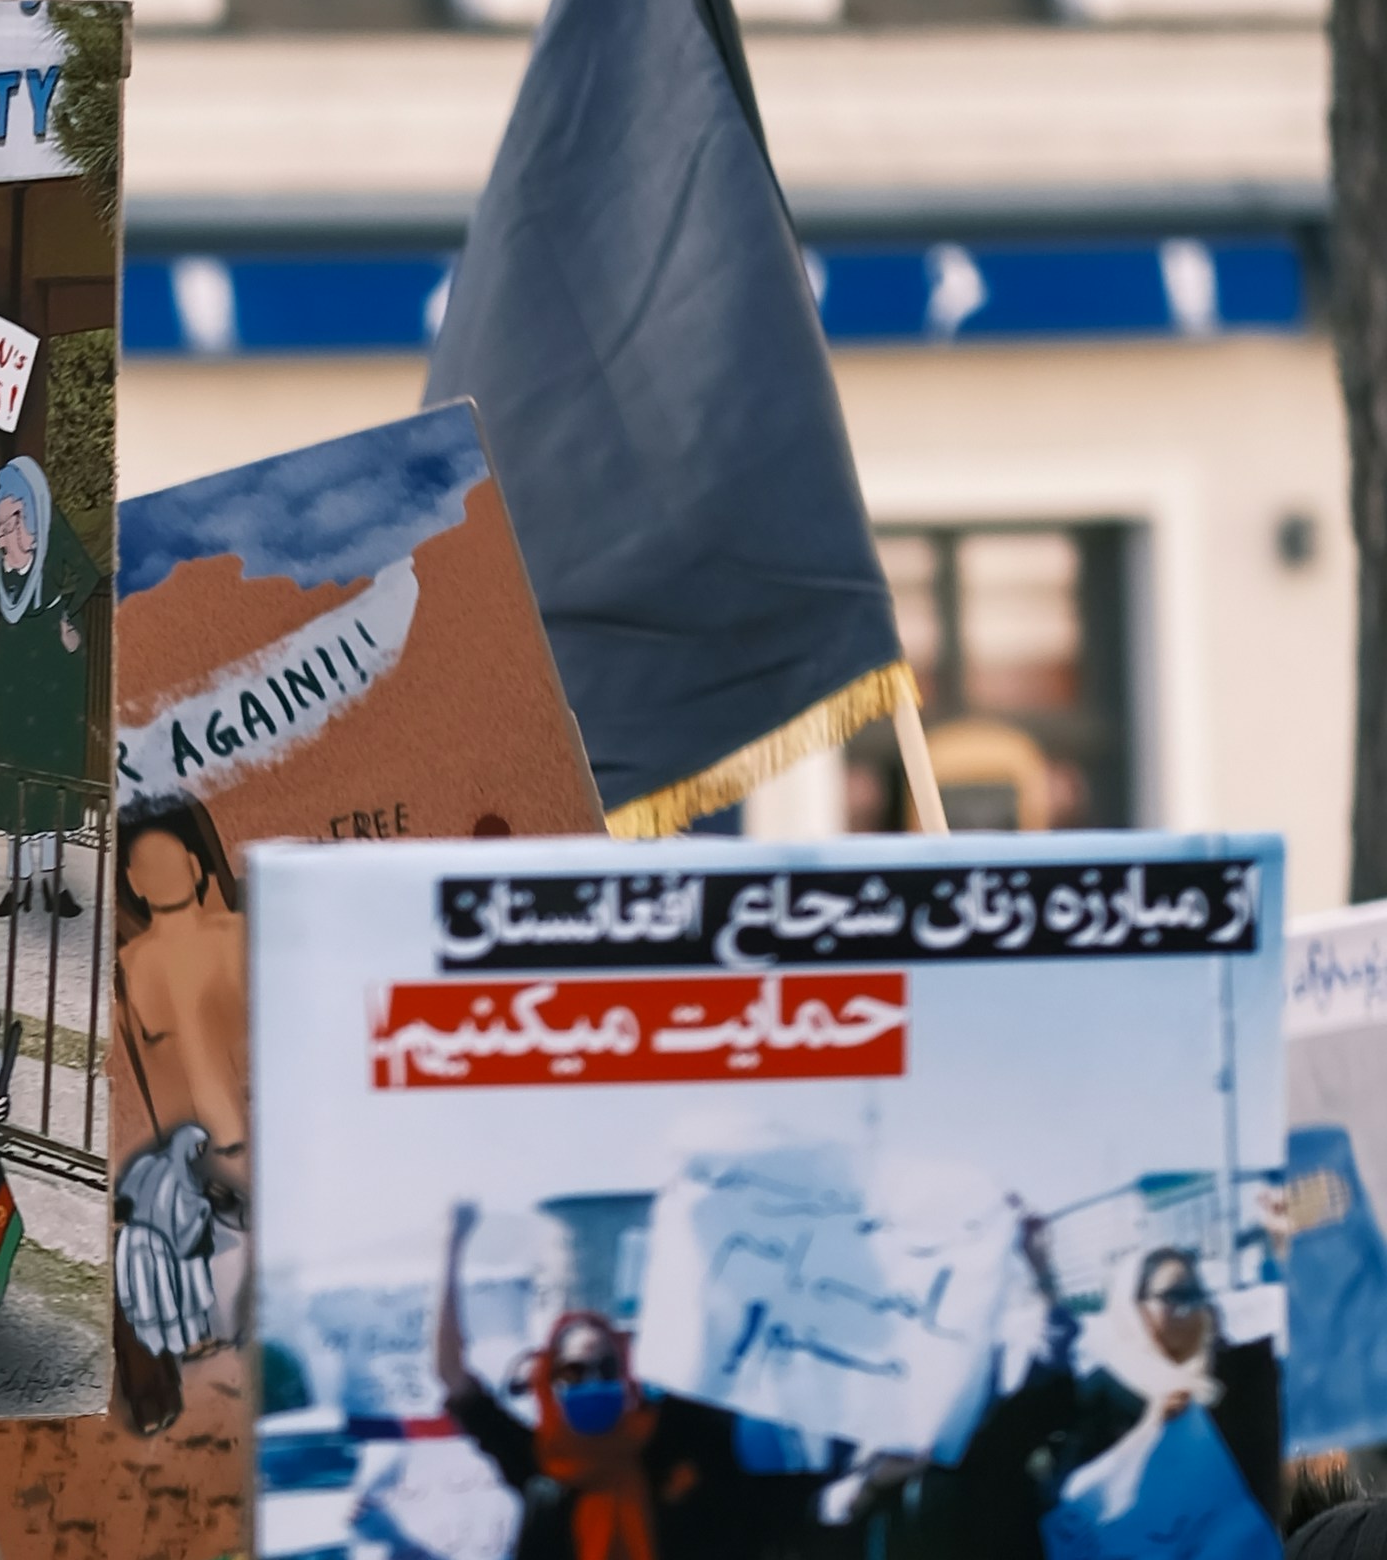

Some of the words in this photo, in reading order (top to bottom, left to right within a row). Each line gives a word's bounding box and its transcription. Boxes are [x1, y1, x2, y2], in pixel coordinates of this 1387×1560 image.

[433, 874, 704, 961] افغانستان
[714, 872, 906, 970] شجاع
[911, 868, 1036, 949] زنان
[1044, 865, 1209, 947] مبارزه
[652, 973, 912, 1069] حمایت
